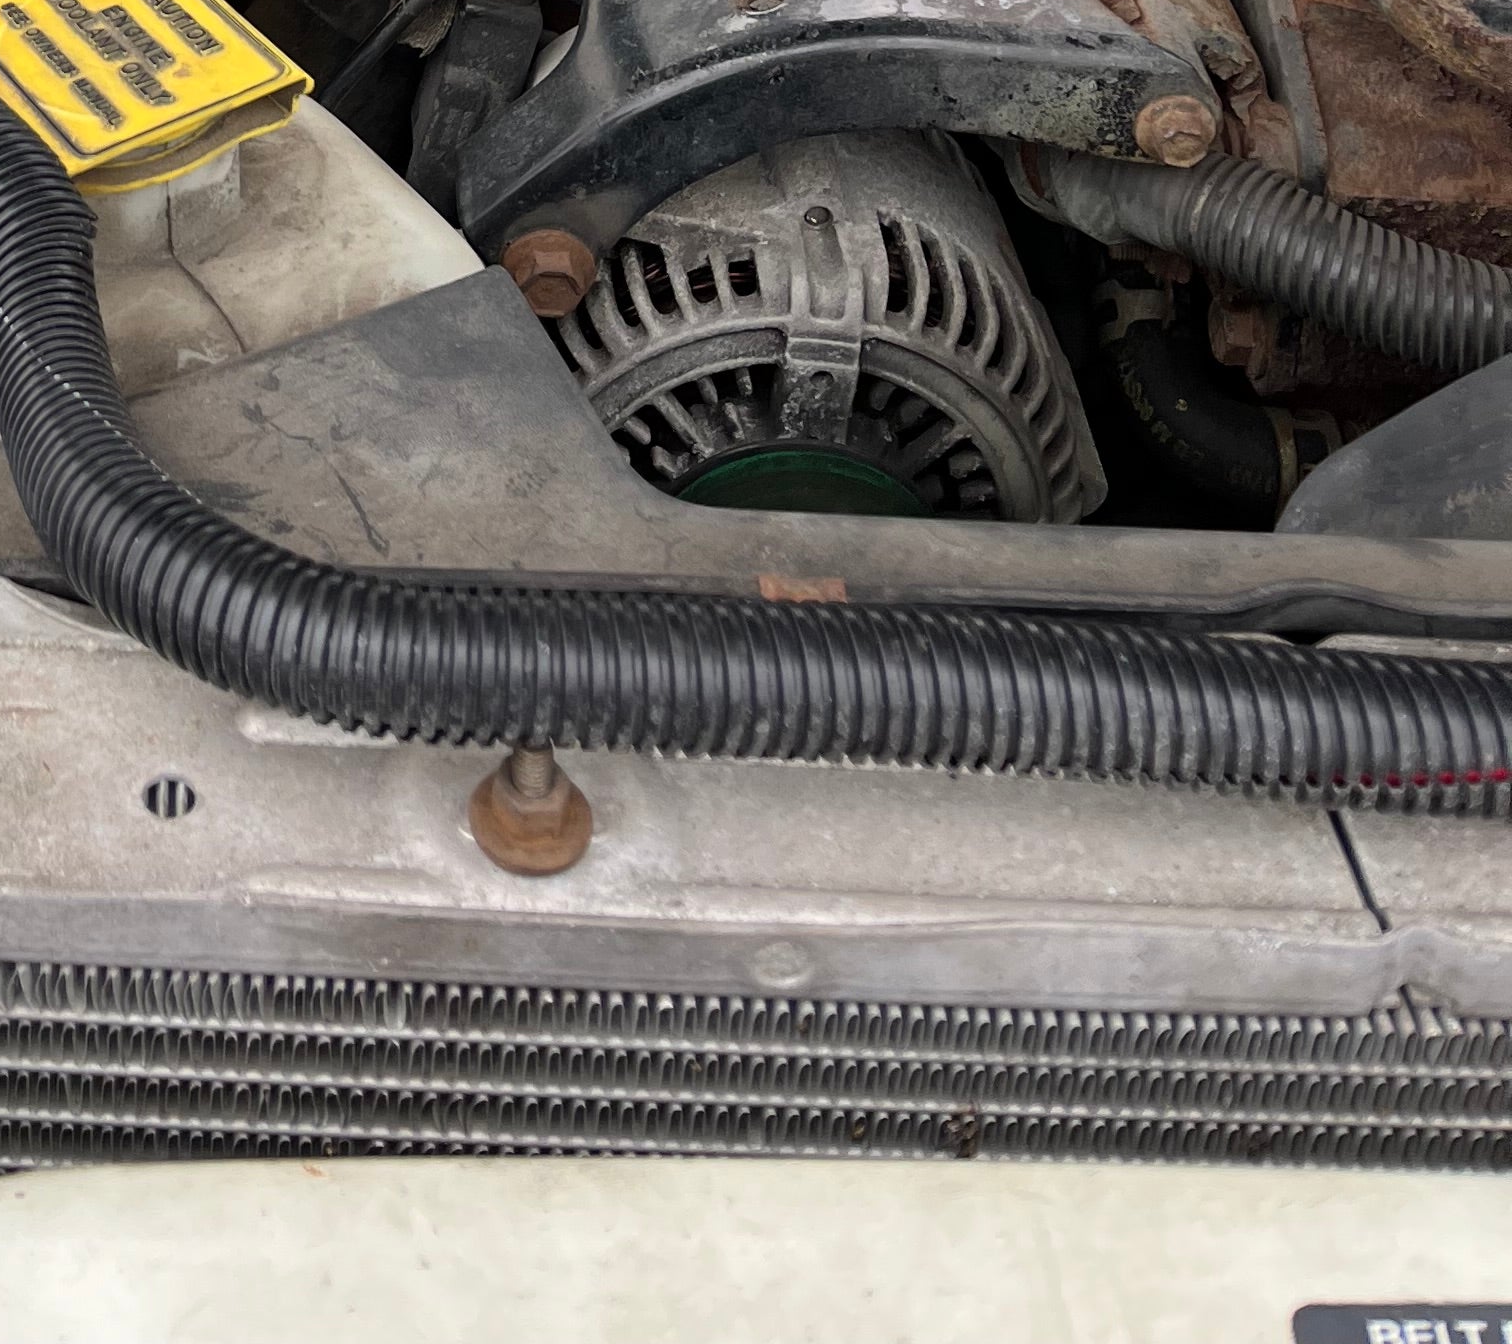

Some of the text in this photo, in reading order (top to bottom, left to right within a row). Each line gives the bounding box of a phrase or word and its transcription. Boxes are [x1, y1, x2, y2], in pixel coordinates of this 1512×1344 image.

[0, 2, 32, 29] SEE
[72, 77, 123, 131] MANUAL
[100, 4, 175, 70] ENGINE
[119, 62, 177, 105] ONLY
